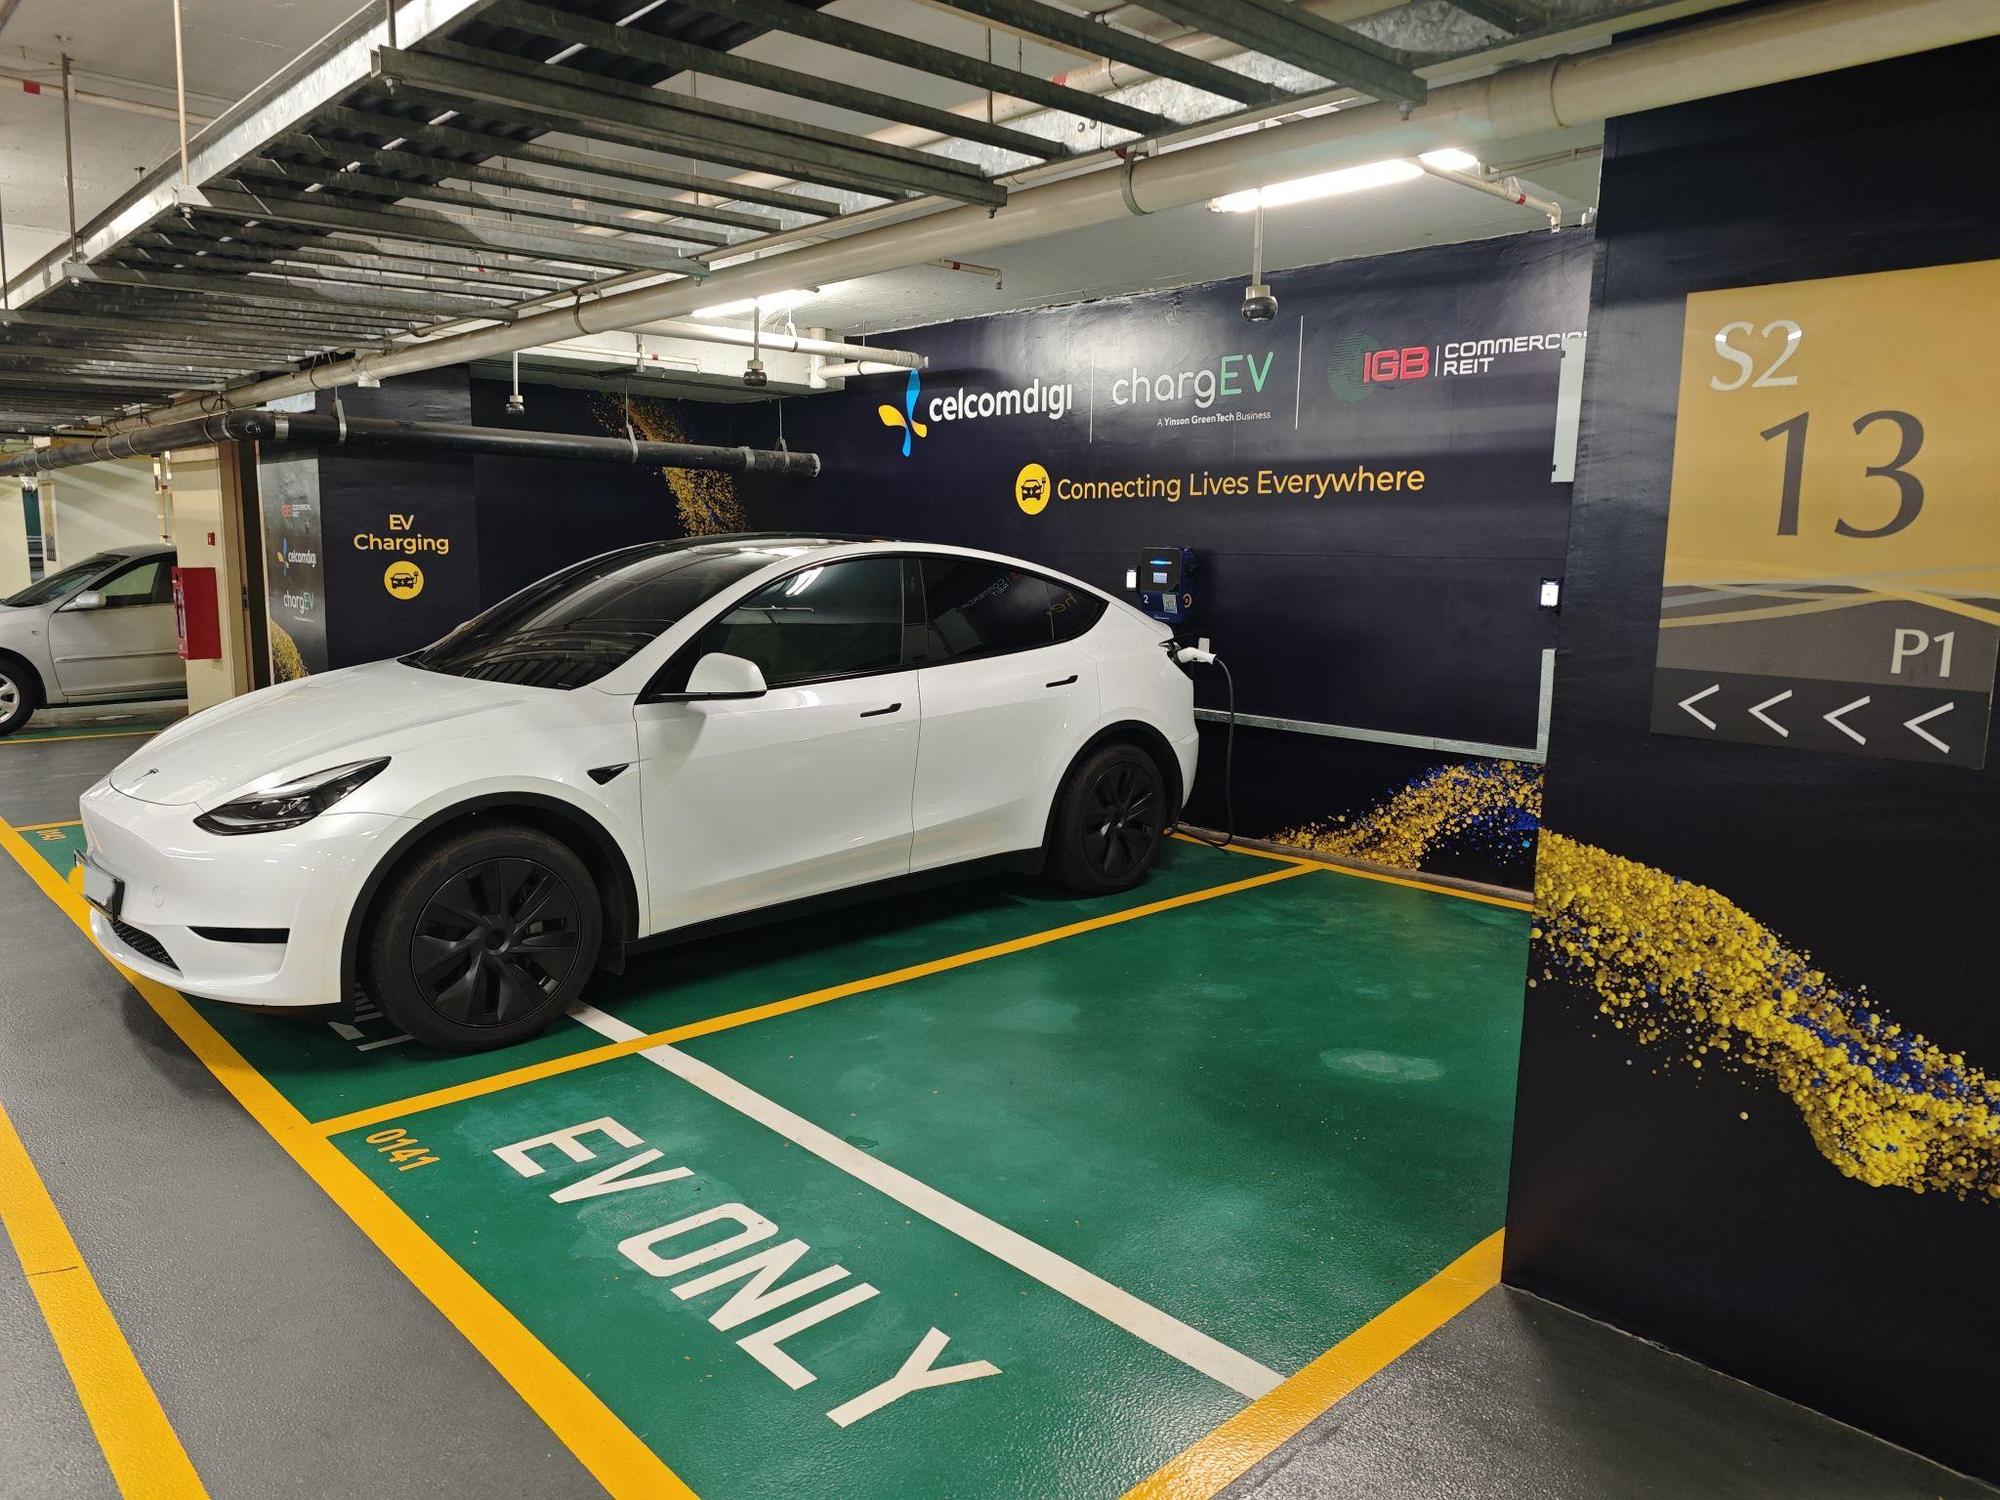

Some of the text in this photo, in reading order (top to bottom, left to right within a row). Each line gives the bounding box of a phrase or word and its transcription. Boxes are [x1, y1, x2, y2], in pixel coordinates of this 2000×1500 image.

[1443, 357, 1494, 376] REIT
[1709, 320, 1802, 391] S2
[928, 378, 1072, 421] celcomdigi
[1111, 351, 1274, 408] chargEV
[1156, 410, 1271, 427] A Yinson GreenTech Business
[1057, 465, 1425, 502] Connecting Lives Everywhere
[1760, 410, 1924, 539] 13
[388, 513, 415, 530] EV
[353, 533, 449, 555] Charging
[1143, 594, 1149, 604] 2
[1890, 628, 1956, 678] P1
[365, 1128, 440, 1171] 0141
[491, 1116, 1003, 1428] EV ONLY
